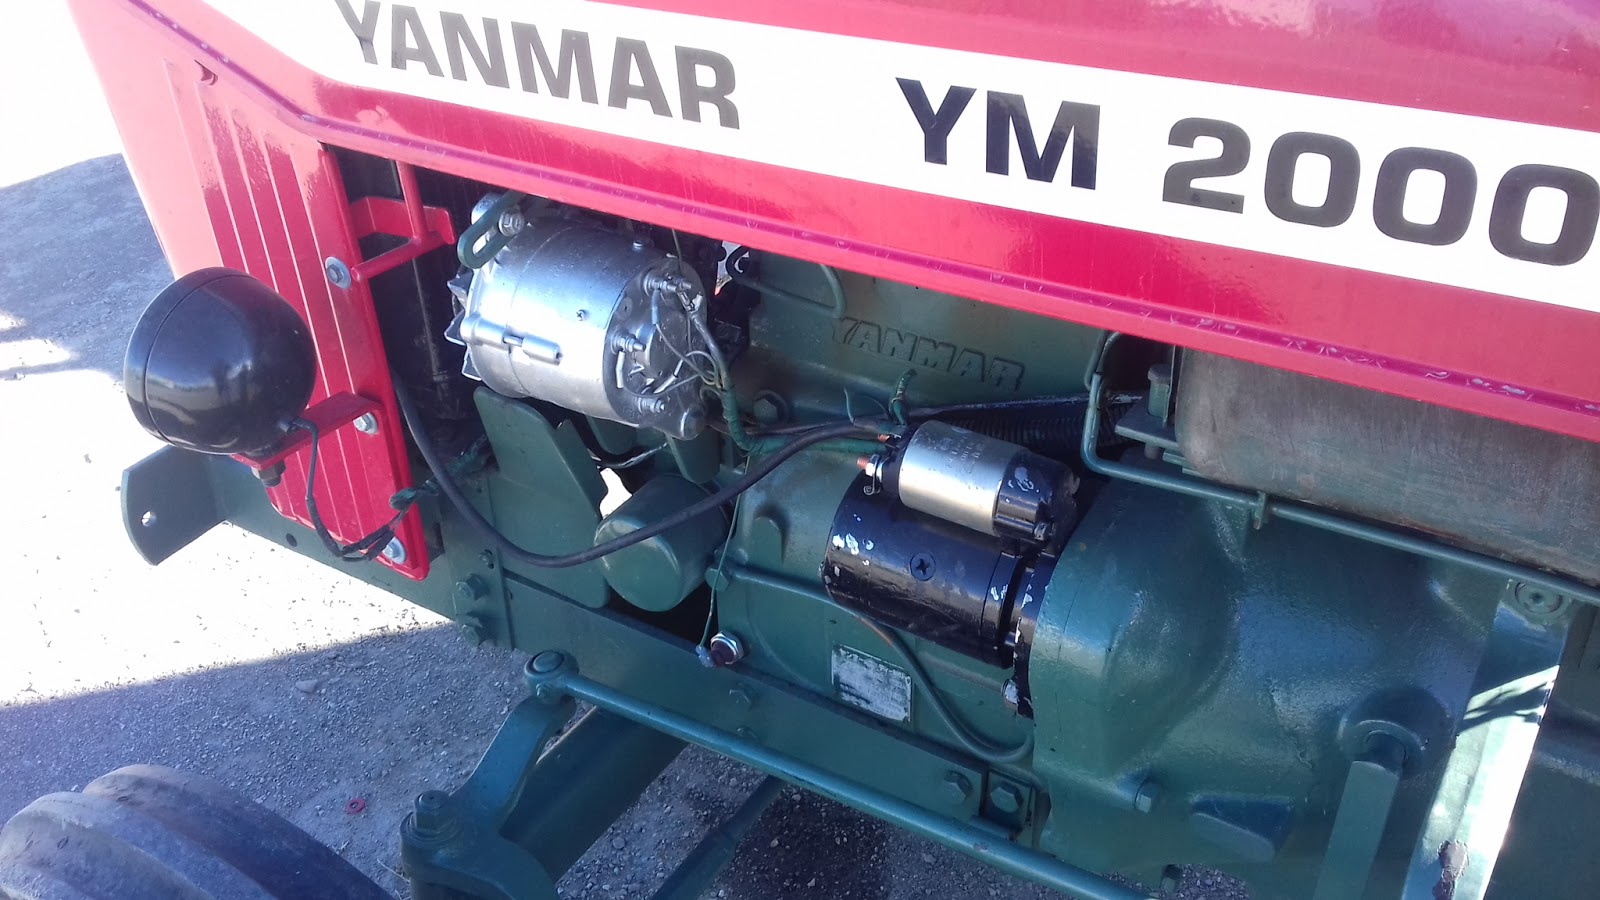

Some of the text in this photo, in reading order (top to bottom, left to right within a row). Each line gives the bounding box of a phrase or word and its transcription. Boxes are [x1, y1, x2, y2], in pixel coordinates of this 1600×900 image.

[335, 0, 1600, 266] YANMAR YM 2000
[832, 316, 1026, 392] YANMAR
